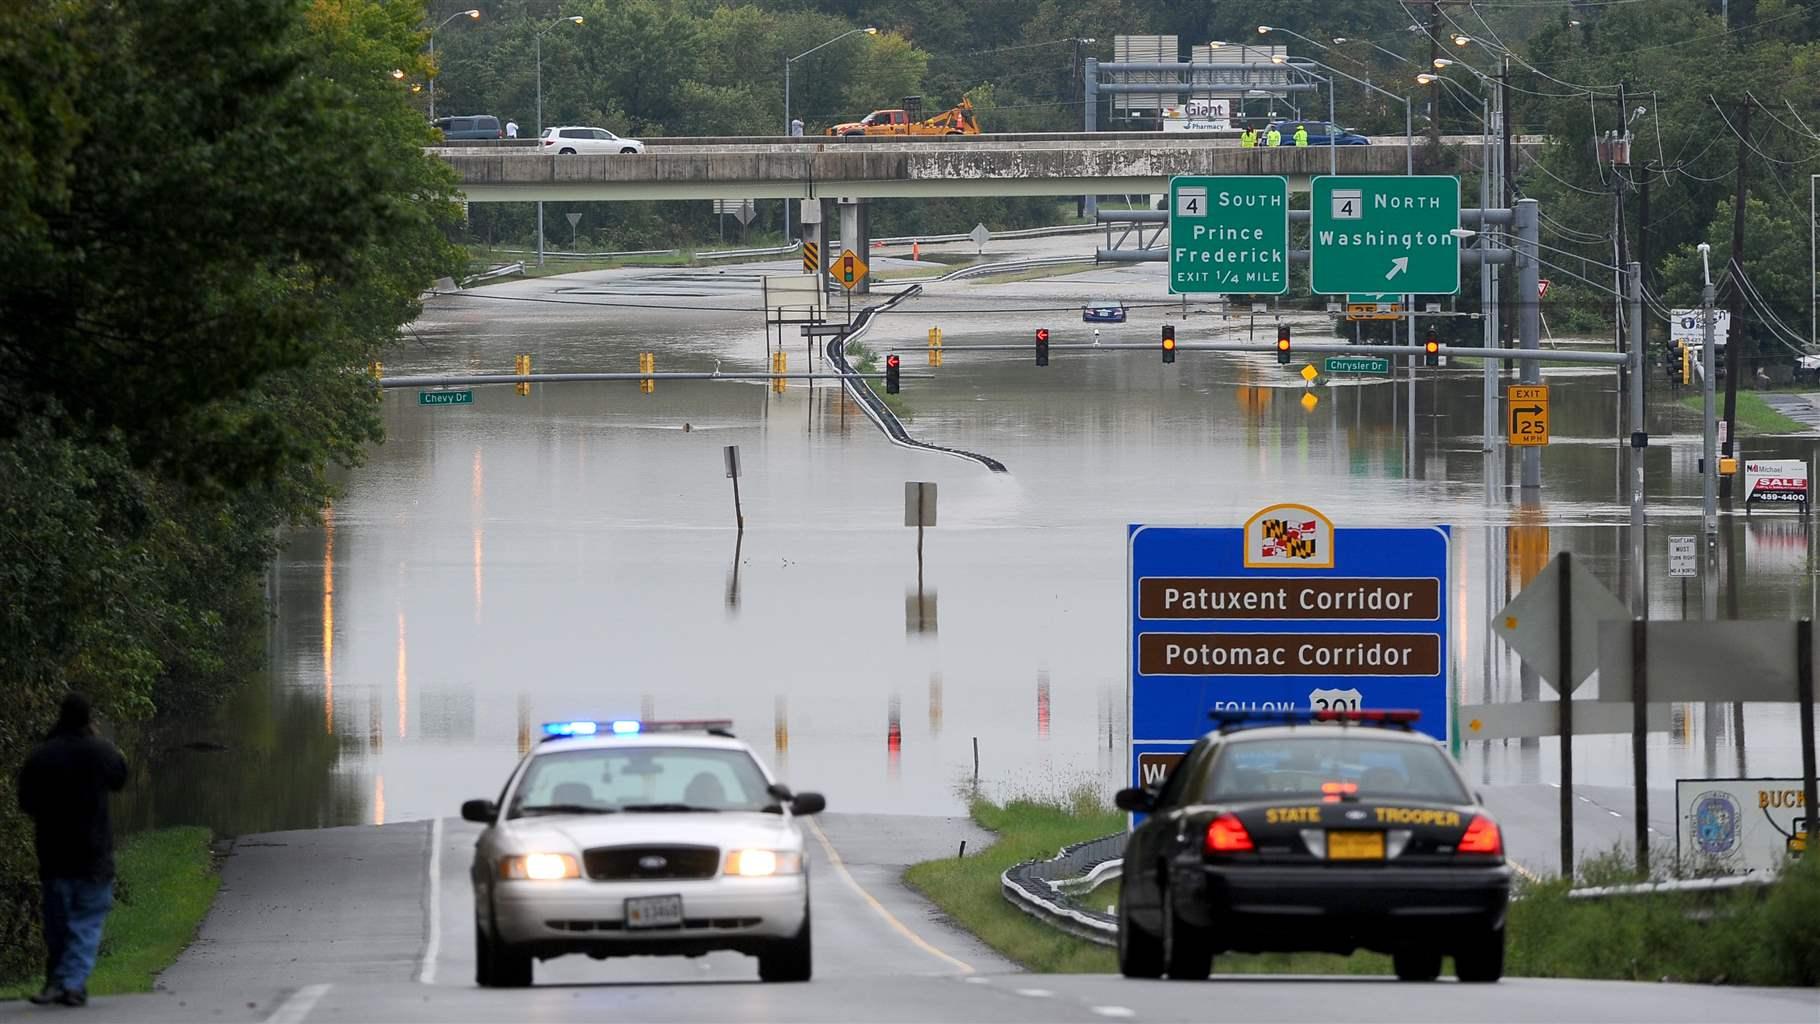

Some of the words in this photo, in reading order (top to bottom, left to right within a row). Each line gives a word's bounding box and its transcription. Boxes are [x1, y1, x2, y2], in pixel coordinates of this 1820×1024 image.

[1184, 102, 1224, 116] Giant
[1186, 198, 1199, 214] 4
[1218, 192, 1281, 207] SOUTH
[1374, 193, 1440, 209] NORTH
[1341, 200, 1353, 216] 4
[1193, 225, 1264, 241] Prince
[1319, 231, 1452, 250] Washington
[1176, 248, 1281, 263] Frederick
[1177, 271, 1209, 282] EXIT
[1216, 269, 1240, 284] 1/4
[1246, 271, 1280, 282] MILE
[1330, 361, 1369, 371] Chrysler
[1371, 362, 1383, 370] Dr
[425, 393, 454, 404] Chevy
[456, 392, 467, 402] Dr
[1516, 390, 1540, 398] EXIT
[1520, 420, 1545, 434] 25
[1759, 464, 1783, 473] Michael
[1759, 478, 1804, 486] SALE
[1760, 493, 1805, 501] 459-4400
[1164, 588, 1287, 609] Patuxent
[1299, 587, 1413, 610] Corridor
[1165, 644, 1286, 665] Potomac
[1298, 643, 1413, 666] Corridor
[1265, 807, 1321, 823] STATE
[1374, 807, 1460, 826] TROOPER
